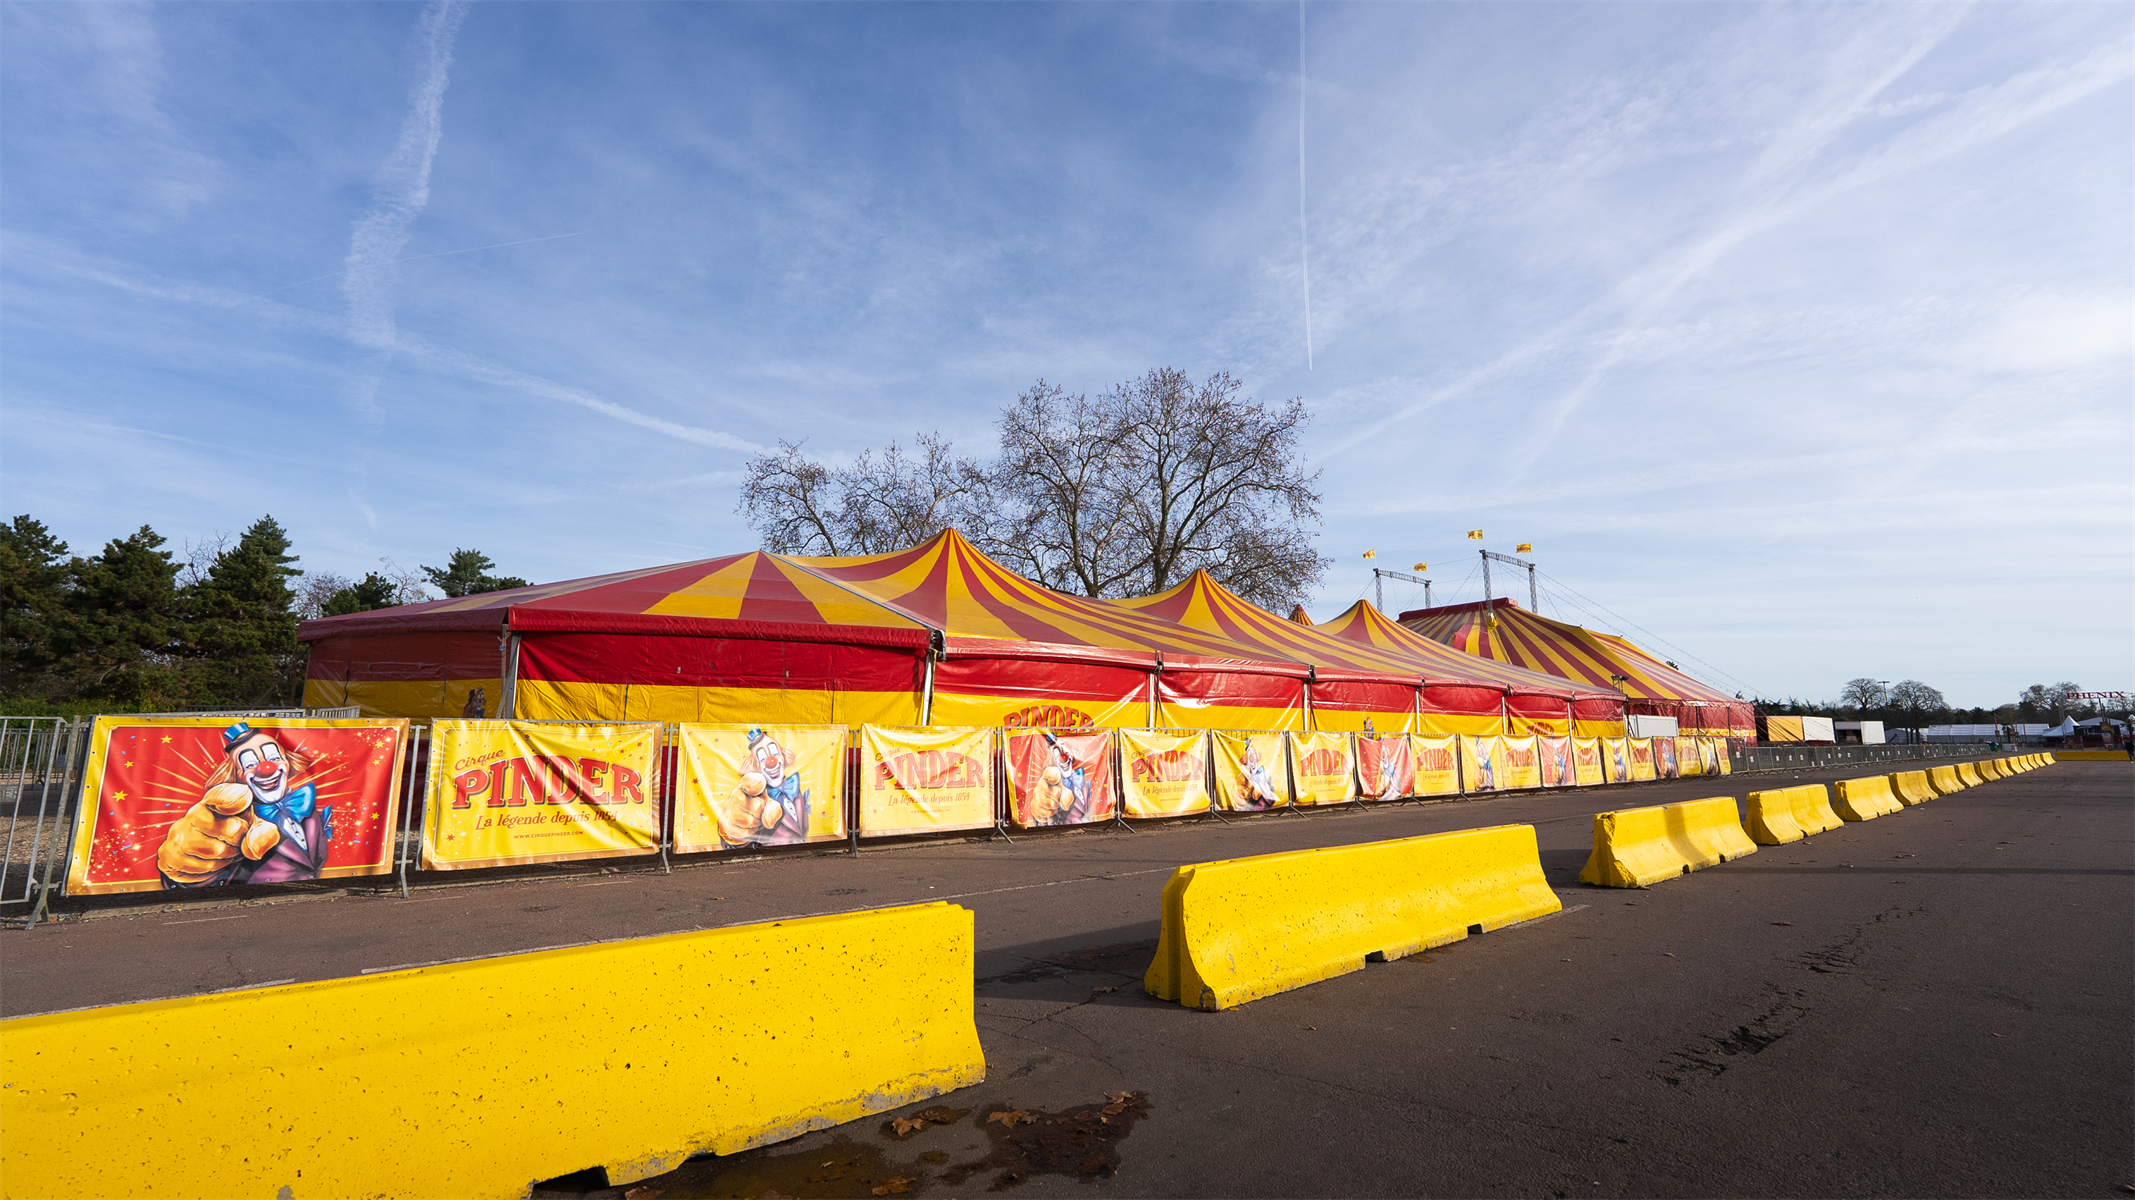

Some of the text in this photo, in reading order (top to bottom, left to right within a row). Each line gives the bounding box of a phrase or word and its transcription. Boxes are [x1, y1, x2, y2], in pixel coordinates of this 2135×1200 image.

[2066, 691, 2125, 699] PHENIX
[454, 749, 506, 771] Cirque
[874, 749, 985, 791] PINDER
[1131, 750, 1206, 783] PINDER
[451, 754, 645, 810] PINDER
[888, 795, 899, 807] La
[930, 794, 954, 805] depuis
[475, 810, 618, 831] La légende depuis 1854
[513, 831, 584, 839] WWW.CIRQUEPINDER.COM
